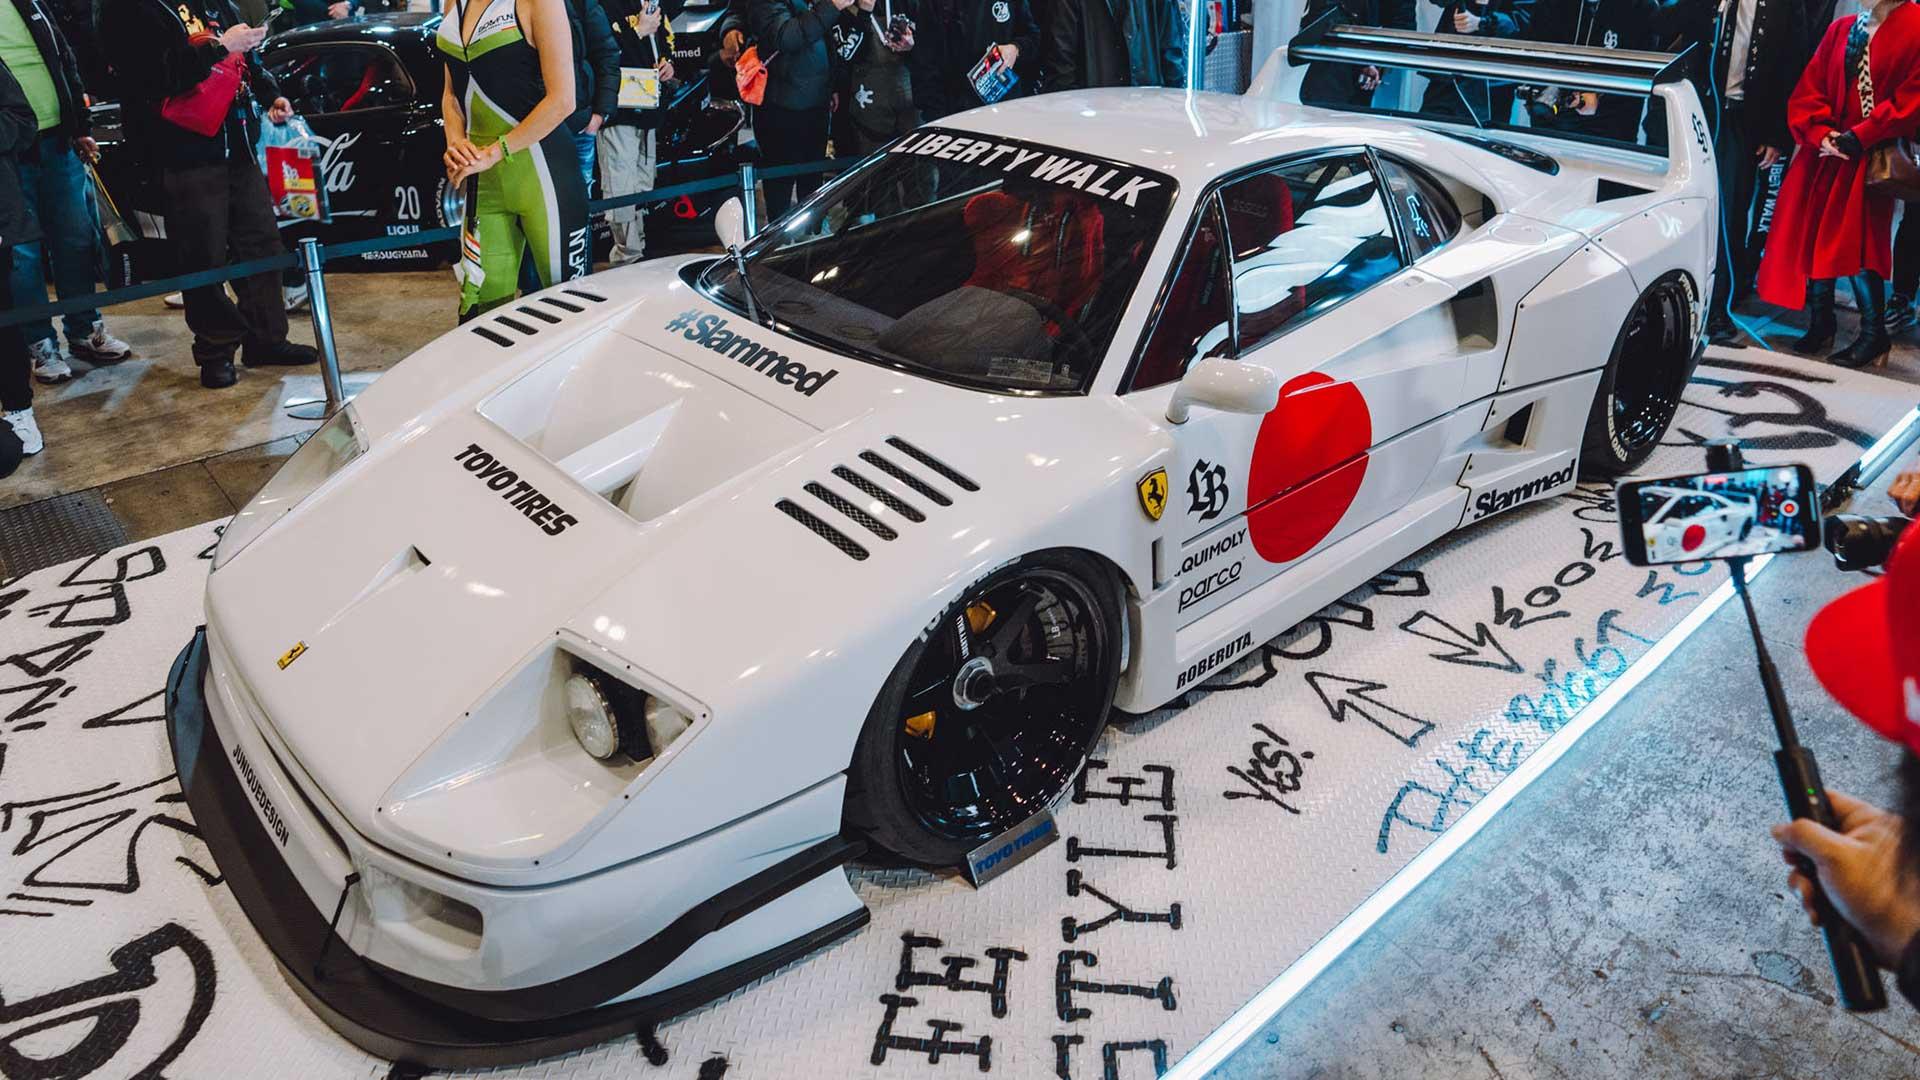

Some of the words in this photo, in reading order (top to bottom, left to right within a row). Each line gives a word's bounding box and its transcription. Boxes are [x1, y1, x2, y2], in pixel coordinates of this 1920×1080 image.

[890, 133, 1043, 173] LIBERTY
[1031, 155, 1161, 207] WALK
[395, 185, 420, 220] 20
[664, 309, 839, 397] #Slammed
[454, 443, 519, 491] TOYO
[502, 480, 579, 536] TIRES
[1186, 458, 1230, 523] LB
[1473, 458, 1577, 520] Slammed
[1175, 528, 1247, 577] QUIMOLY
[1178, 561, 1242, 614] parco
